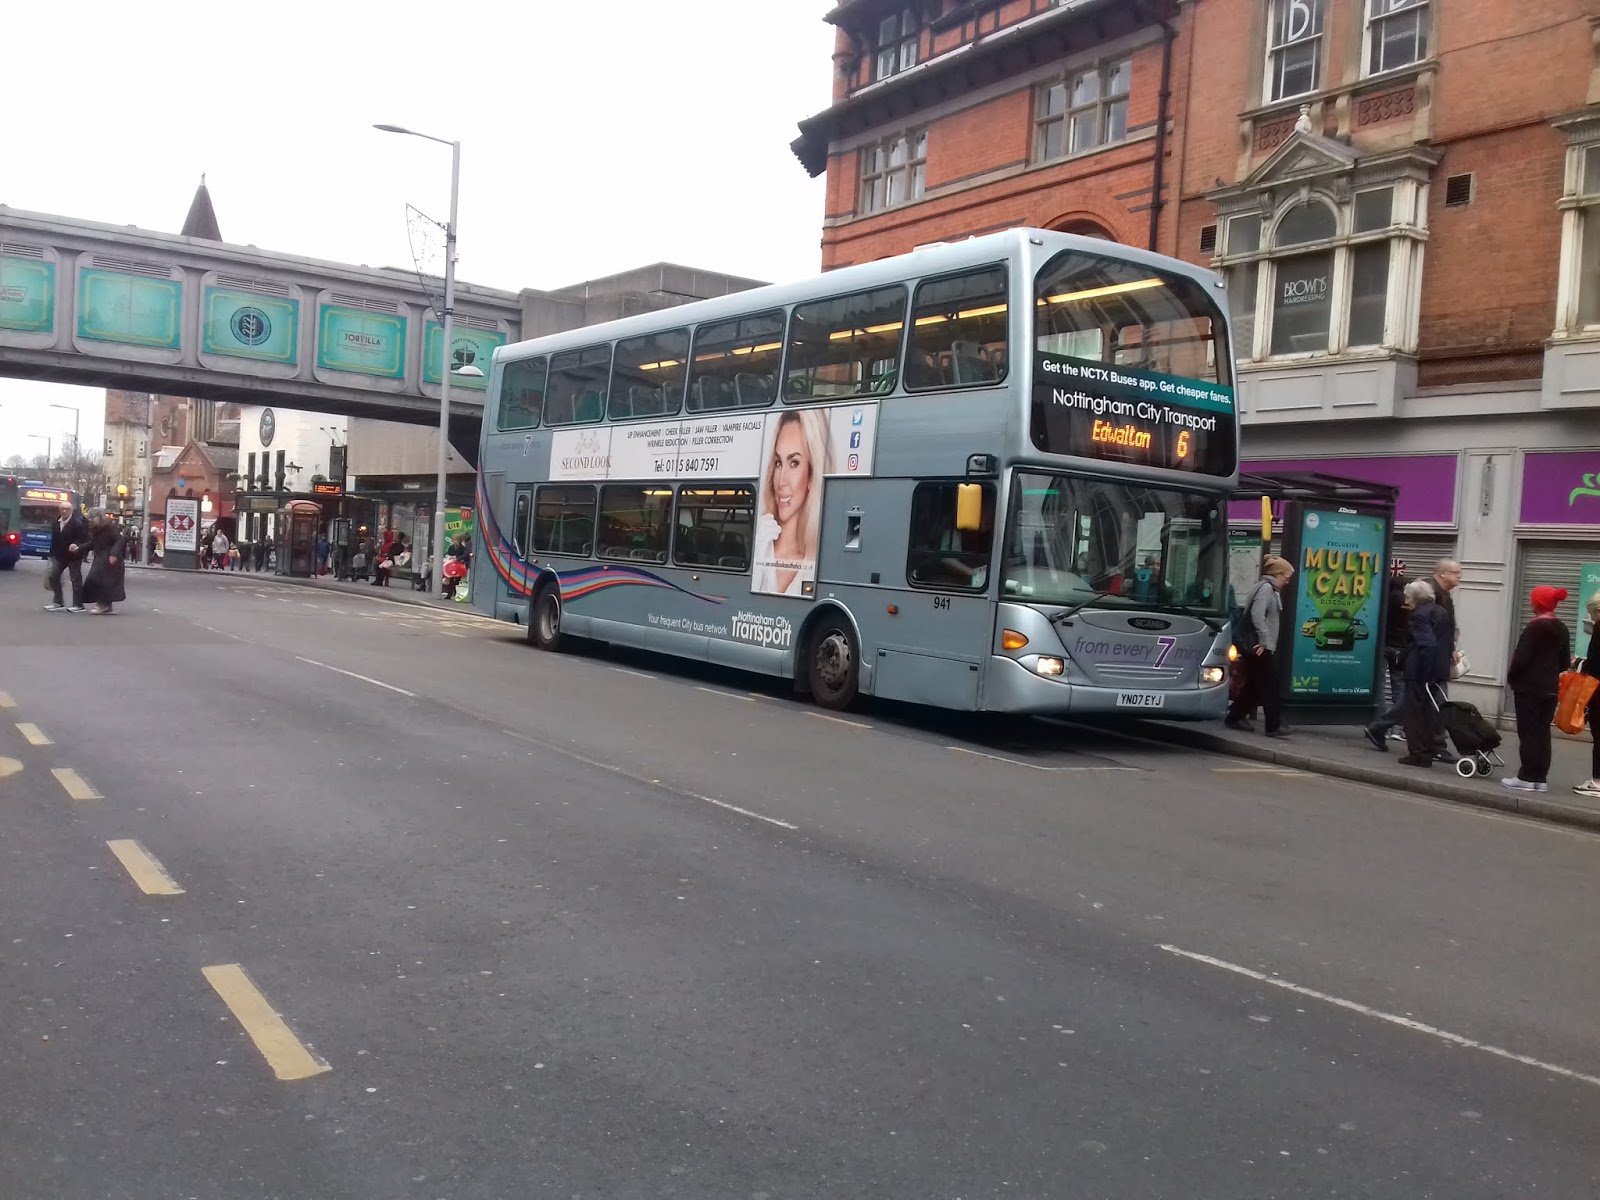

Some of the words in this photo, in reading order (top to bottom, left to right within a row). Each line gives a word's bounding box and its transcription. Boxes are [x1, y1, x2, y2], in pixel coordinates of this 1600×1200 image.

[344, 333, 381, 346] TORTILLA
[1042, 360, 1060, 374] Get
[1062, 364, 1078, 376] the
[1080, 366, 1109, 381] NCTX
[1110, 371, 1138, 387] Buses
[1139, 378, 1158, 391] app.
[1159, 381, 1176, 394] Get
[1176, 385, 1209, 400] cheaper
[1210, 390, 1231, 404] fares.
[1053, 388, 1135, 417] Nottingham
[1136, 402, 1163, 424] City
[1162, 407, 1217, 432] Transport
[633, 429, 662, 439] ENHANCEMENT
[665, 427, 678, 436] CHEEK
[679, 426, 691, 435] FILLER
[695, 425, 704, 434] JAW
[704, 424, 718, 433] FILLER
[722, 422, 742, 432] VAMPIRE
[742, 421, 761, 430] FACIALS
[1092, 419, 1151, 449] Edwalton
[1176, 430, 1190, 458] 6
[647, 439, 665, 448] WRINKLE
[665, 437, 688, 447] REDUCTION
[692, 437, 704, 445] FILLER
[704, 435, 734, 445] CORRECTION
[561, 457, 589, 469] SECOND
[590, 456, 612, 469] LOOK
[654, 460, 665, 473] Tel:
[666, 459, 684, 472] 0115
[685, 458, 699, 471] 840
[700, 457, 719, 471] 7591
[1304, 547, 1380, 574] MULTI
[1314, 572, 1366, 597] CAR
[934, 596, 951, 610] 941
[647, 613, 660, 624] Your
[660, 614, 681, 628] frequent
[681, 618, 692, 632] City
[693, 620, 704, 632] bus
[704, 623, 728, 635] network
[738, 610, 775, 626] Nottingham
[775, 615, 790, 629] City
[732, 615, 792, 647] Transport
[1075, 636, 1109, 655] from
[1113, 643, 1153, 661] every
[1153, 635, 1177, 669] 7
[1121, 694, 1143, 705] YN07
[1145, 694, 1162, 706] EYJ
